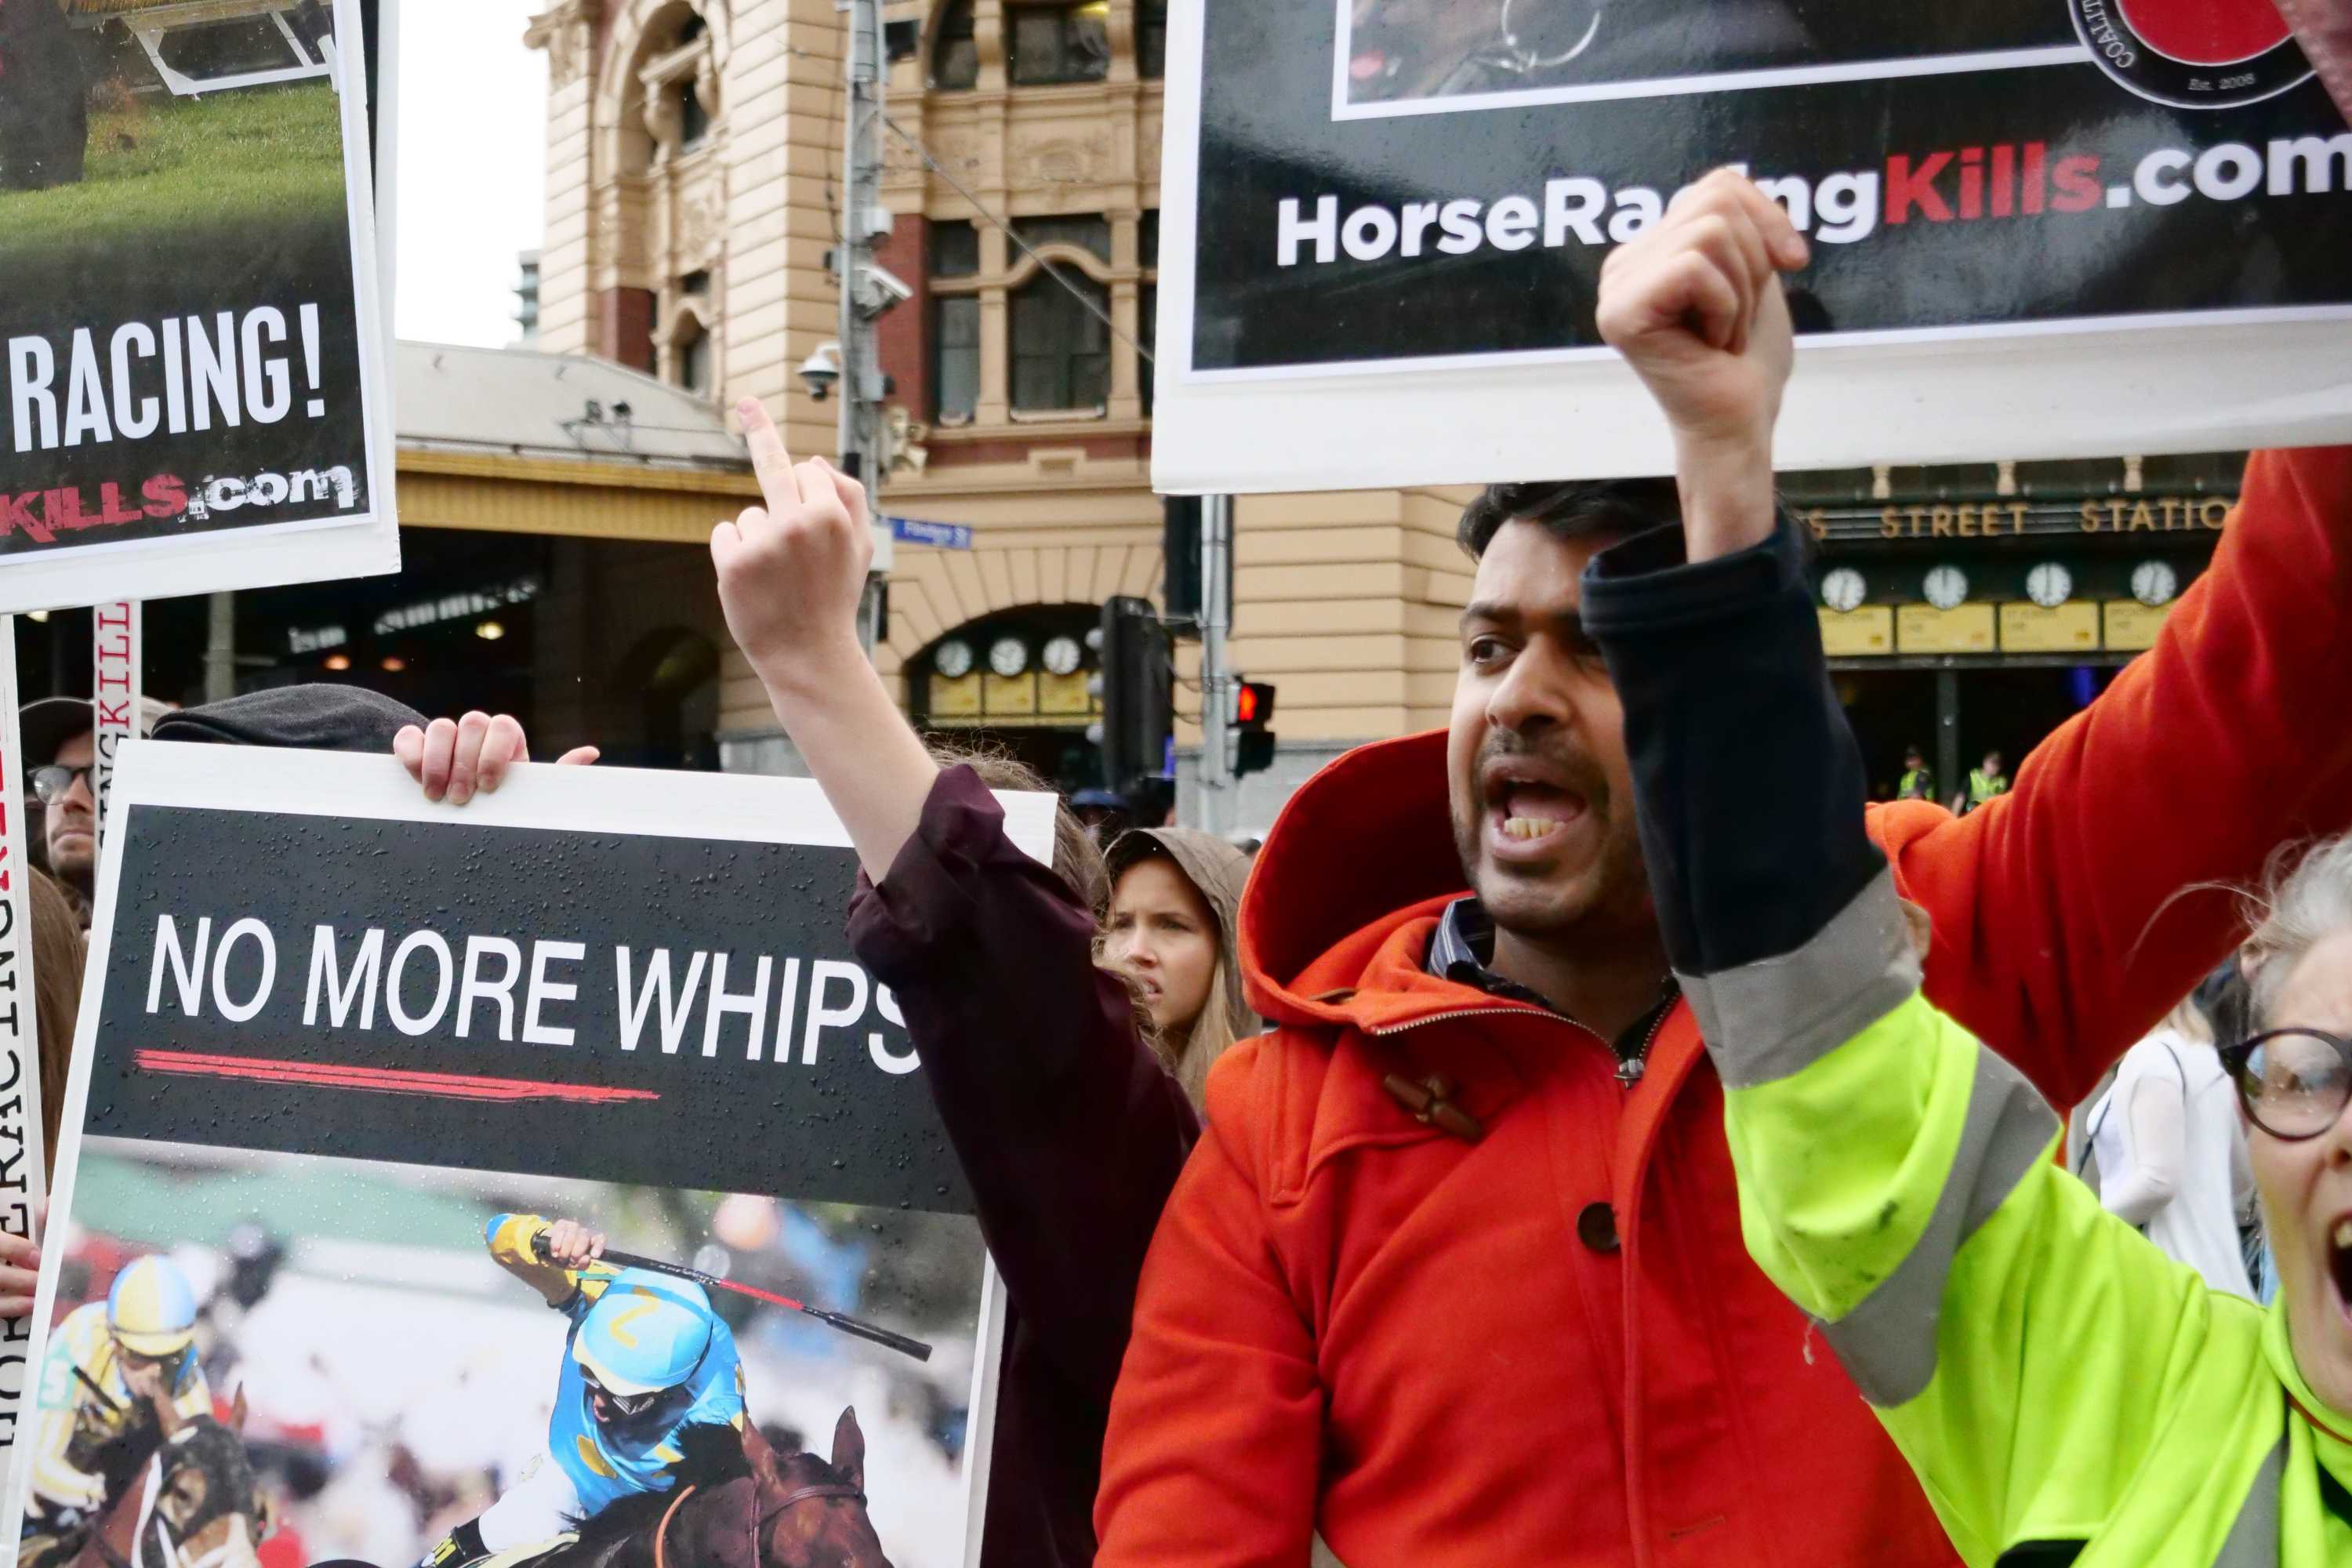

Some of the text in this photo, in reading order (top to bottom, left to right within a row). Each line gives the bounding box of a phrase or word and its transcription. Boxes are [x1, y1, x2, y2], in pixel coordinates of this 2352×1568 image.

[1276, 132, 2352, 267] HorseRangKills.com
[8, 303, 325, 452] RACING!
[1879, 495, 2231, 539] STREET STATIO
[146, 914, 922, 1075] NO MORE WHIPS
